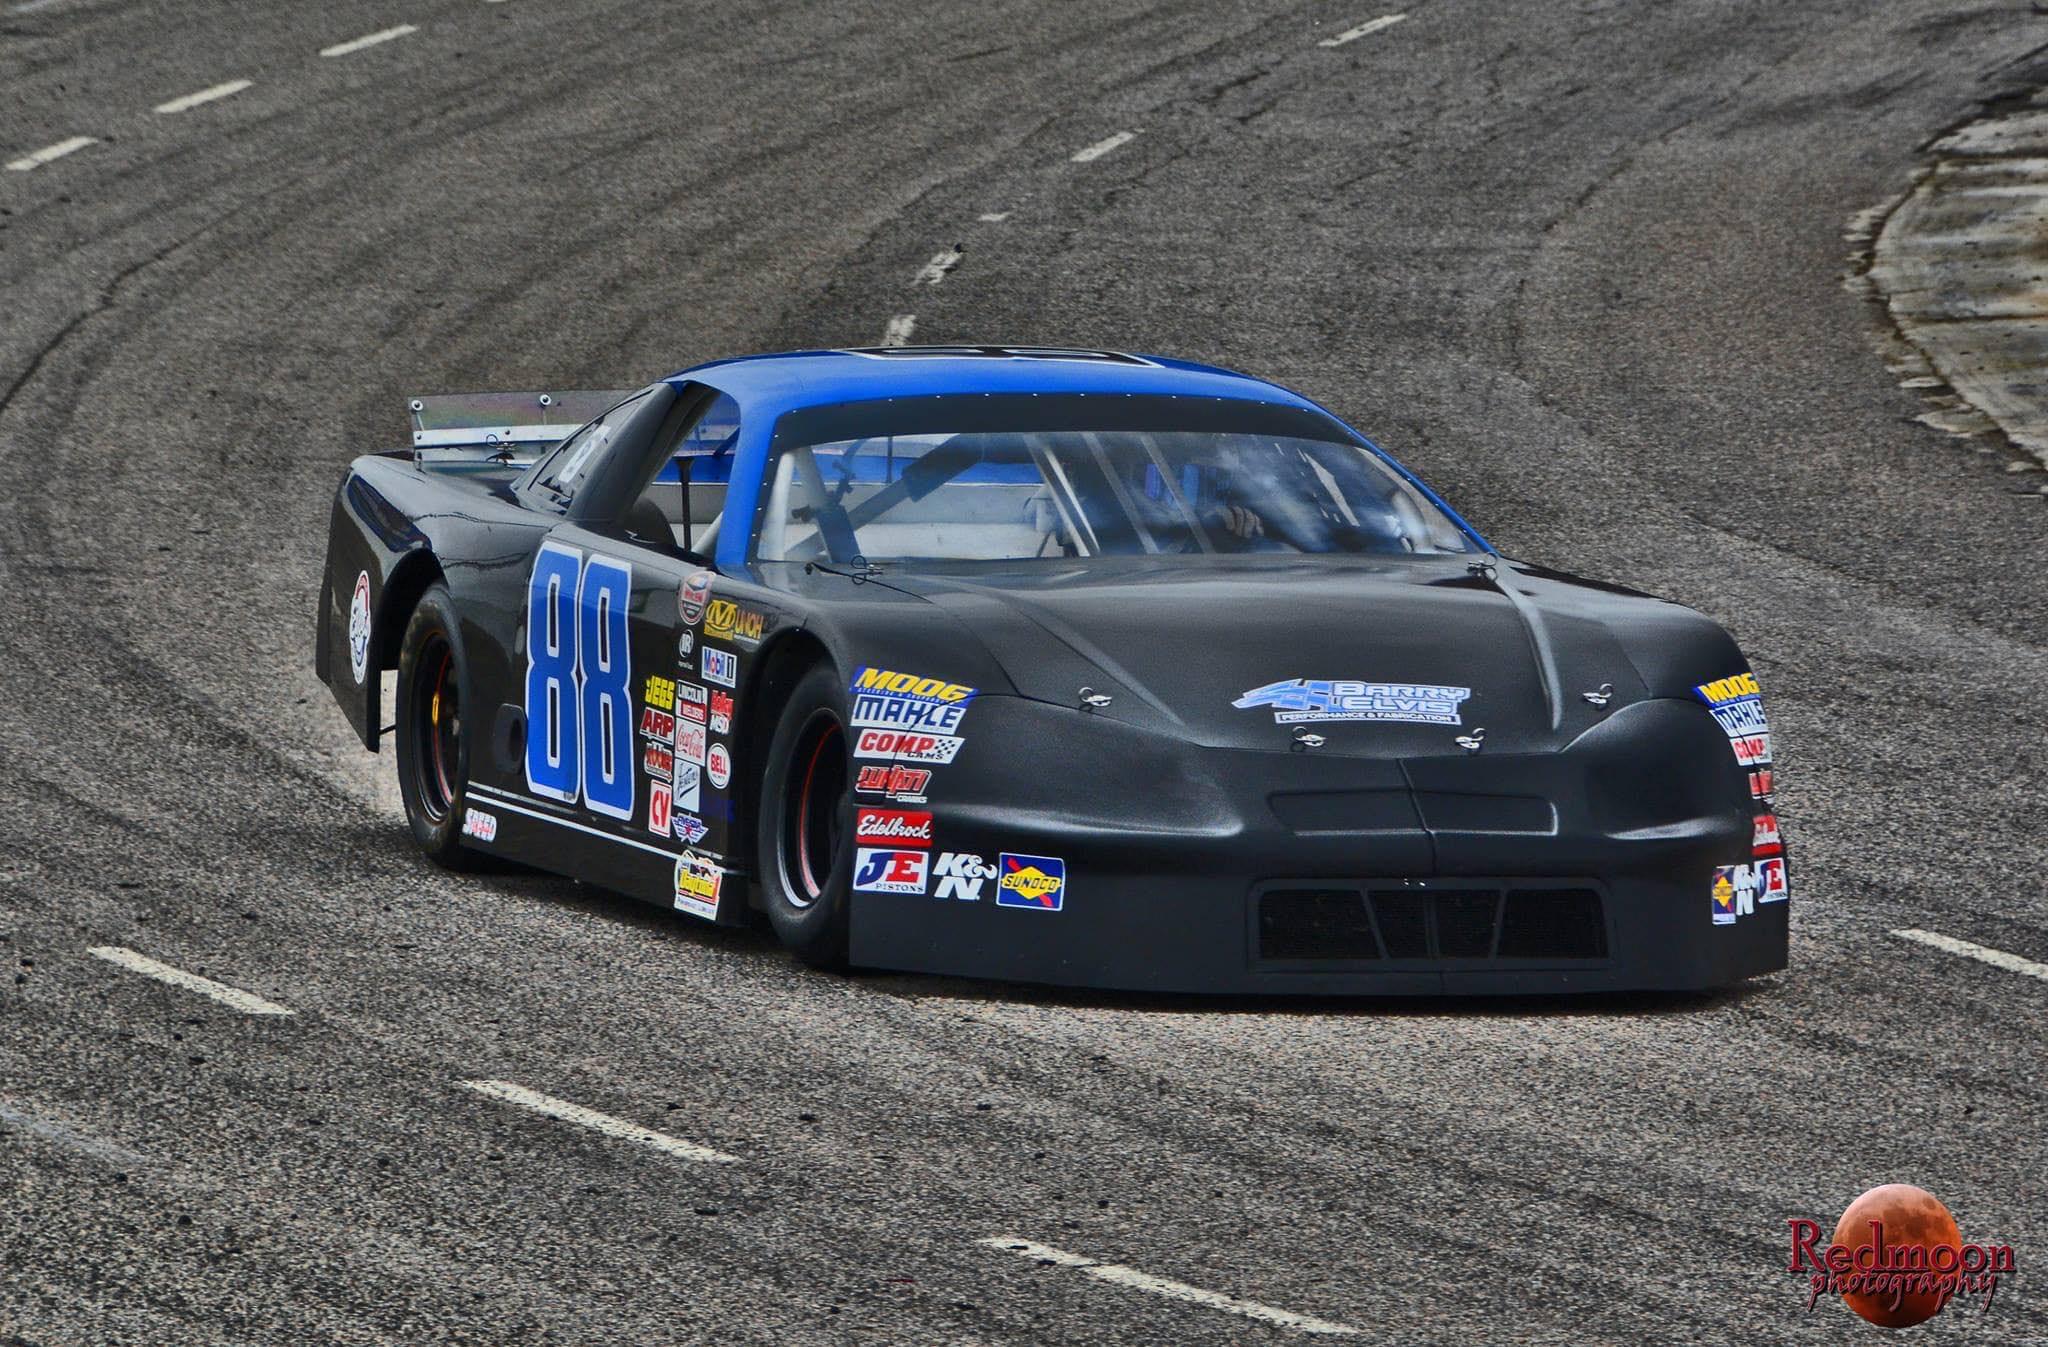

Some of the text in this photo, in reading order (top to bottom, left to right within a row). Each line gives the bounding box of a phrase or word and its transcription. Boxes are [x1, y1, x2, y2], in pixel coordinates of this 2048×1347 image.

[525, 540, 635, 821] 88
[645, 675, 675, 711] JEGS
[854, 668, 974, 703] MOOG
[1333, 682, 1467, 700] BARRY
[1698, 672, 1760, 704] MOOG
[855, 696, 961, 728] MAHLE
[1281, 712, 1366, 721] PERFORMANCE
[1377, 712, 1451, 722] FABRICATION
[1341, 696, 1453, 712] ELVIS
[1713, 700, 1766, 730] MAHLE
[642, 708, 674, 738] ARP
[860, 732, 935, 753] COMP
[907, 750, 945, 760] CAMS
[711, 753, 727, 775] BELL
[652, 789, 670, 828] CV
[857, 815, 931, 839] Edelbrock
[856, 852, 923, 886] JE
[875, 882, 924, 893] PISTONS
[1004, 875, 1058, 891] SUNOCO
